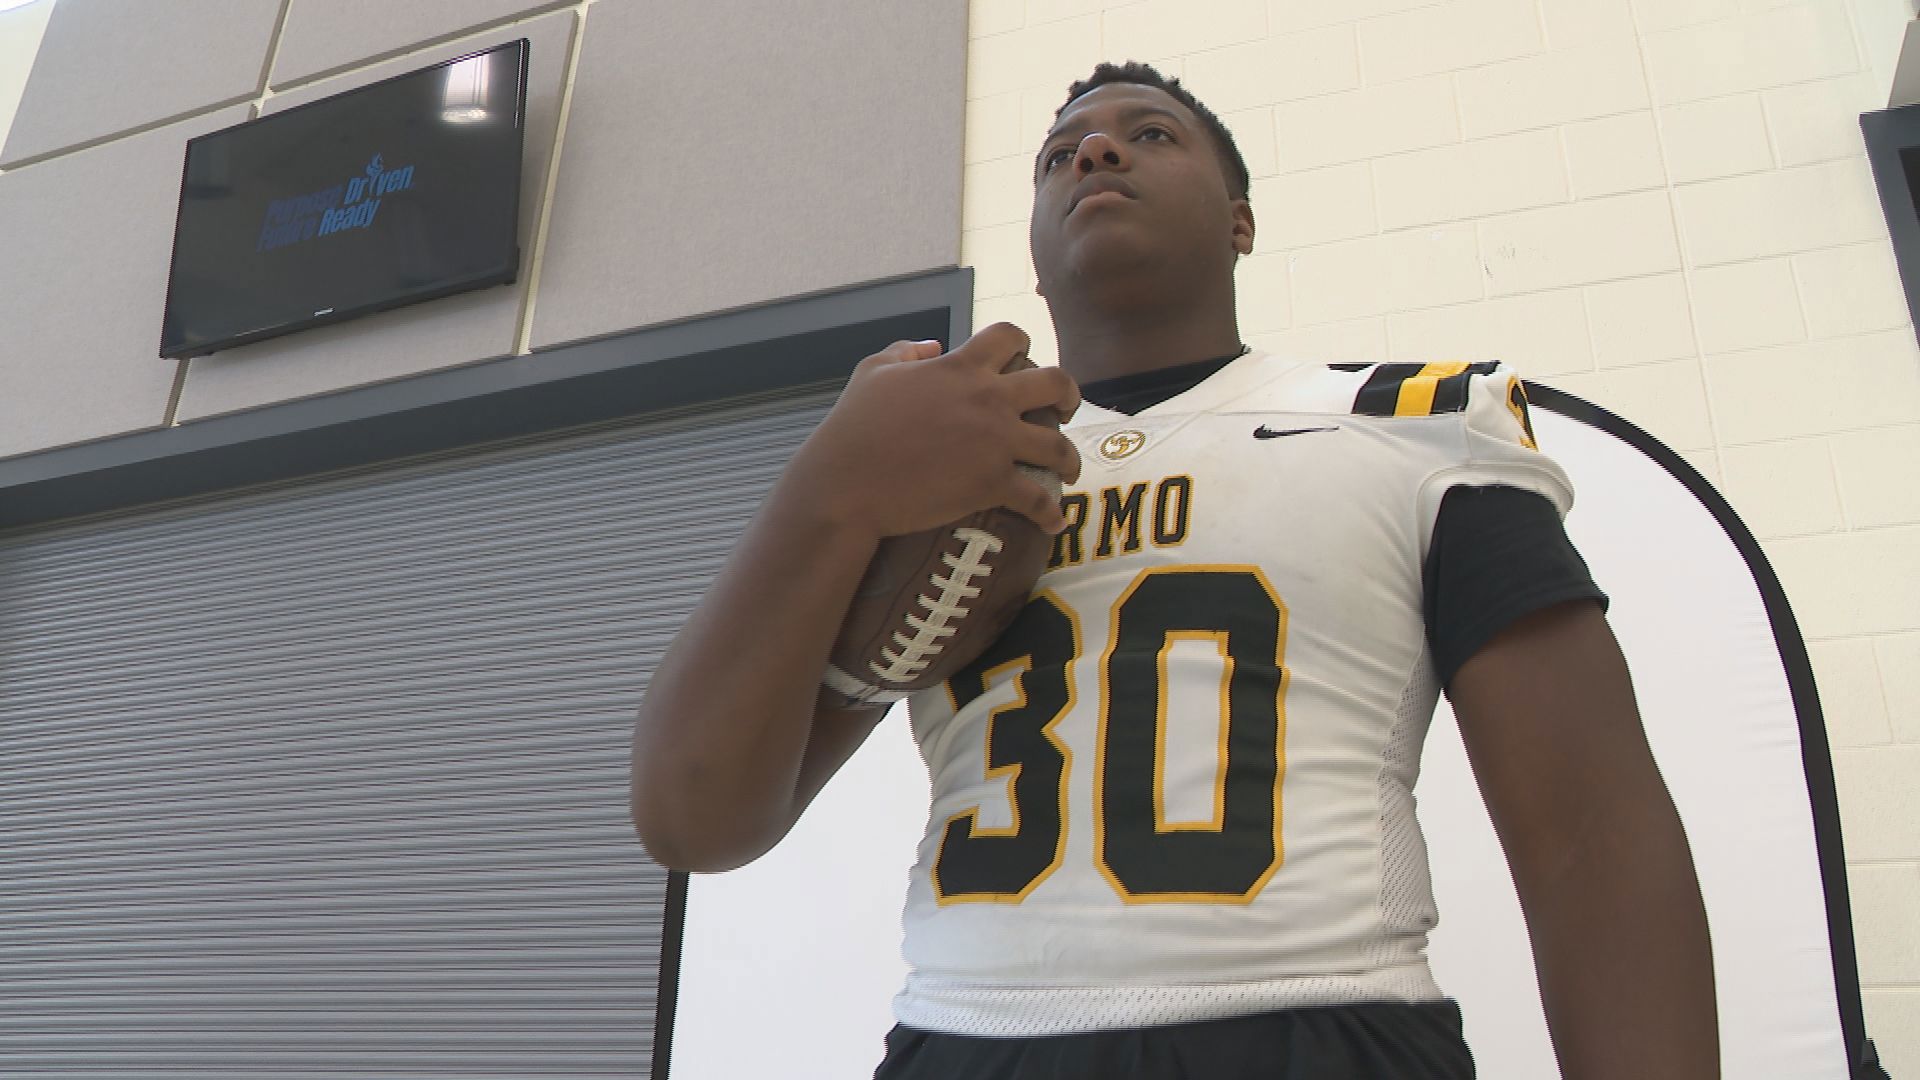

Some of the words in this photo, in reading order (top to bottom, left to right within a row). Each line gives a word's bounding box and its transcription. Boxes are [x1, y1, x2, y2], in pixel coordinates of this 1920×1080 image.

[318, 198, 382, 237] Ready
[344, 155, 415, 205] Driven
[1045, 474, 1194, 574] RMO
[931, 563, 1290, 907] 30
